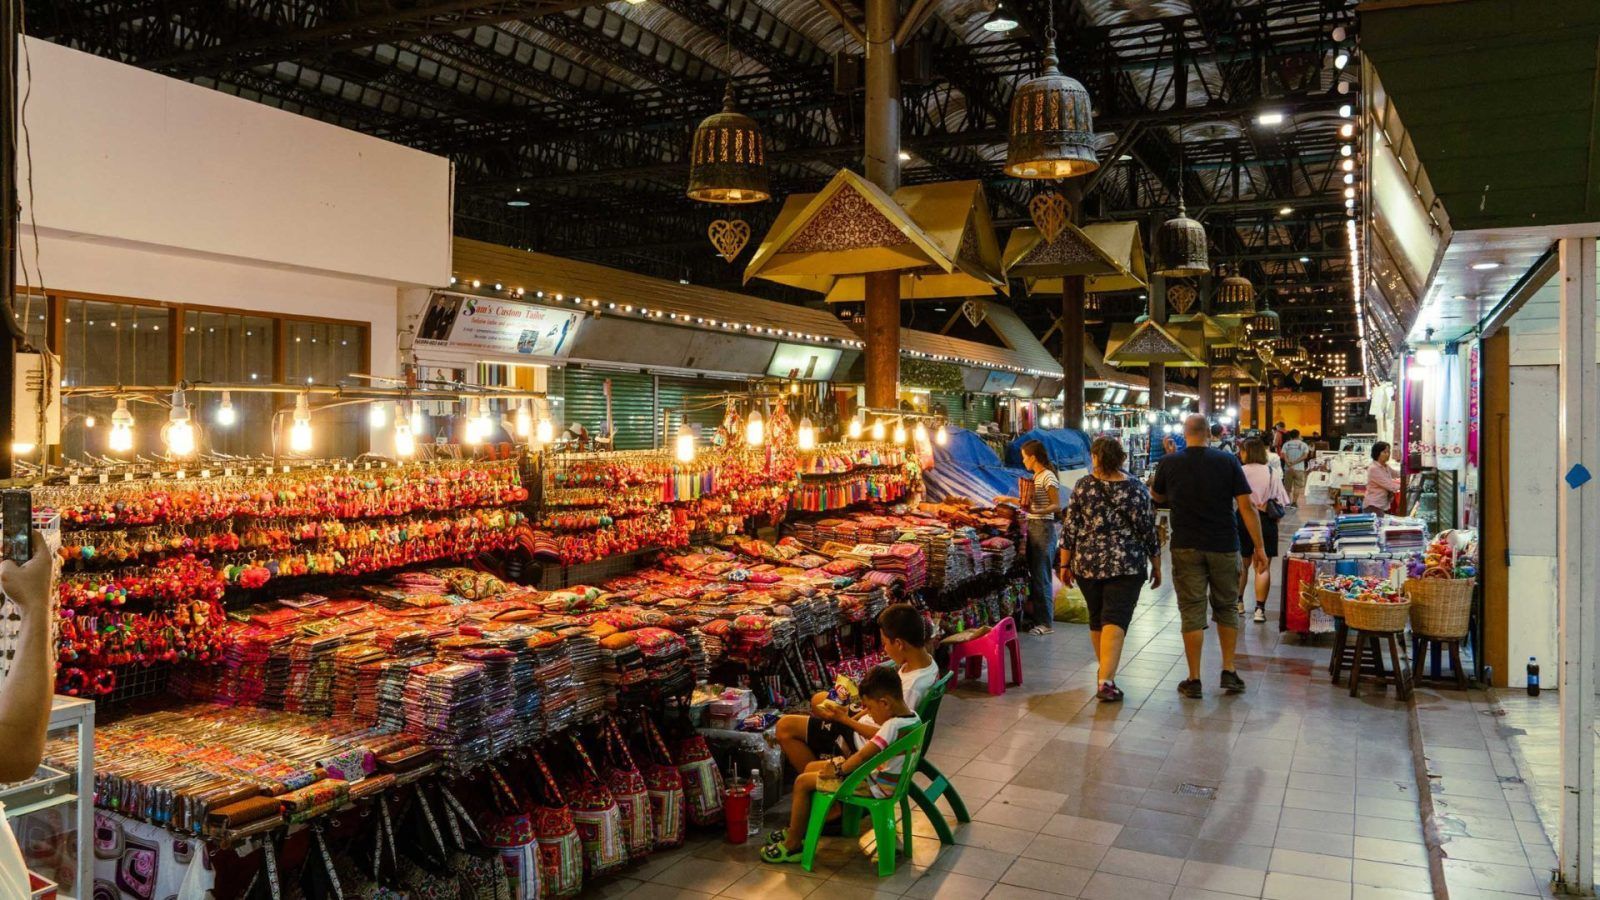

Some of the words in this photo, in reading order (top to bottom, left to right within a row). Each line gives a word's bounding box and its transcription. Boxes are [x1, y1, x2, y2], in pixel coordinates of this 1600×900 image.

[463, 298, 492, 316] Sam's
[495, 306, 522, 318] Custom
[526, 309, 546, 320] Tailor
